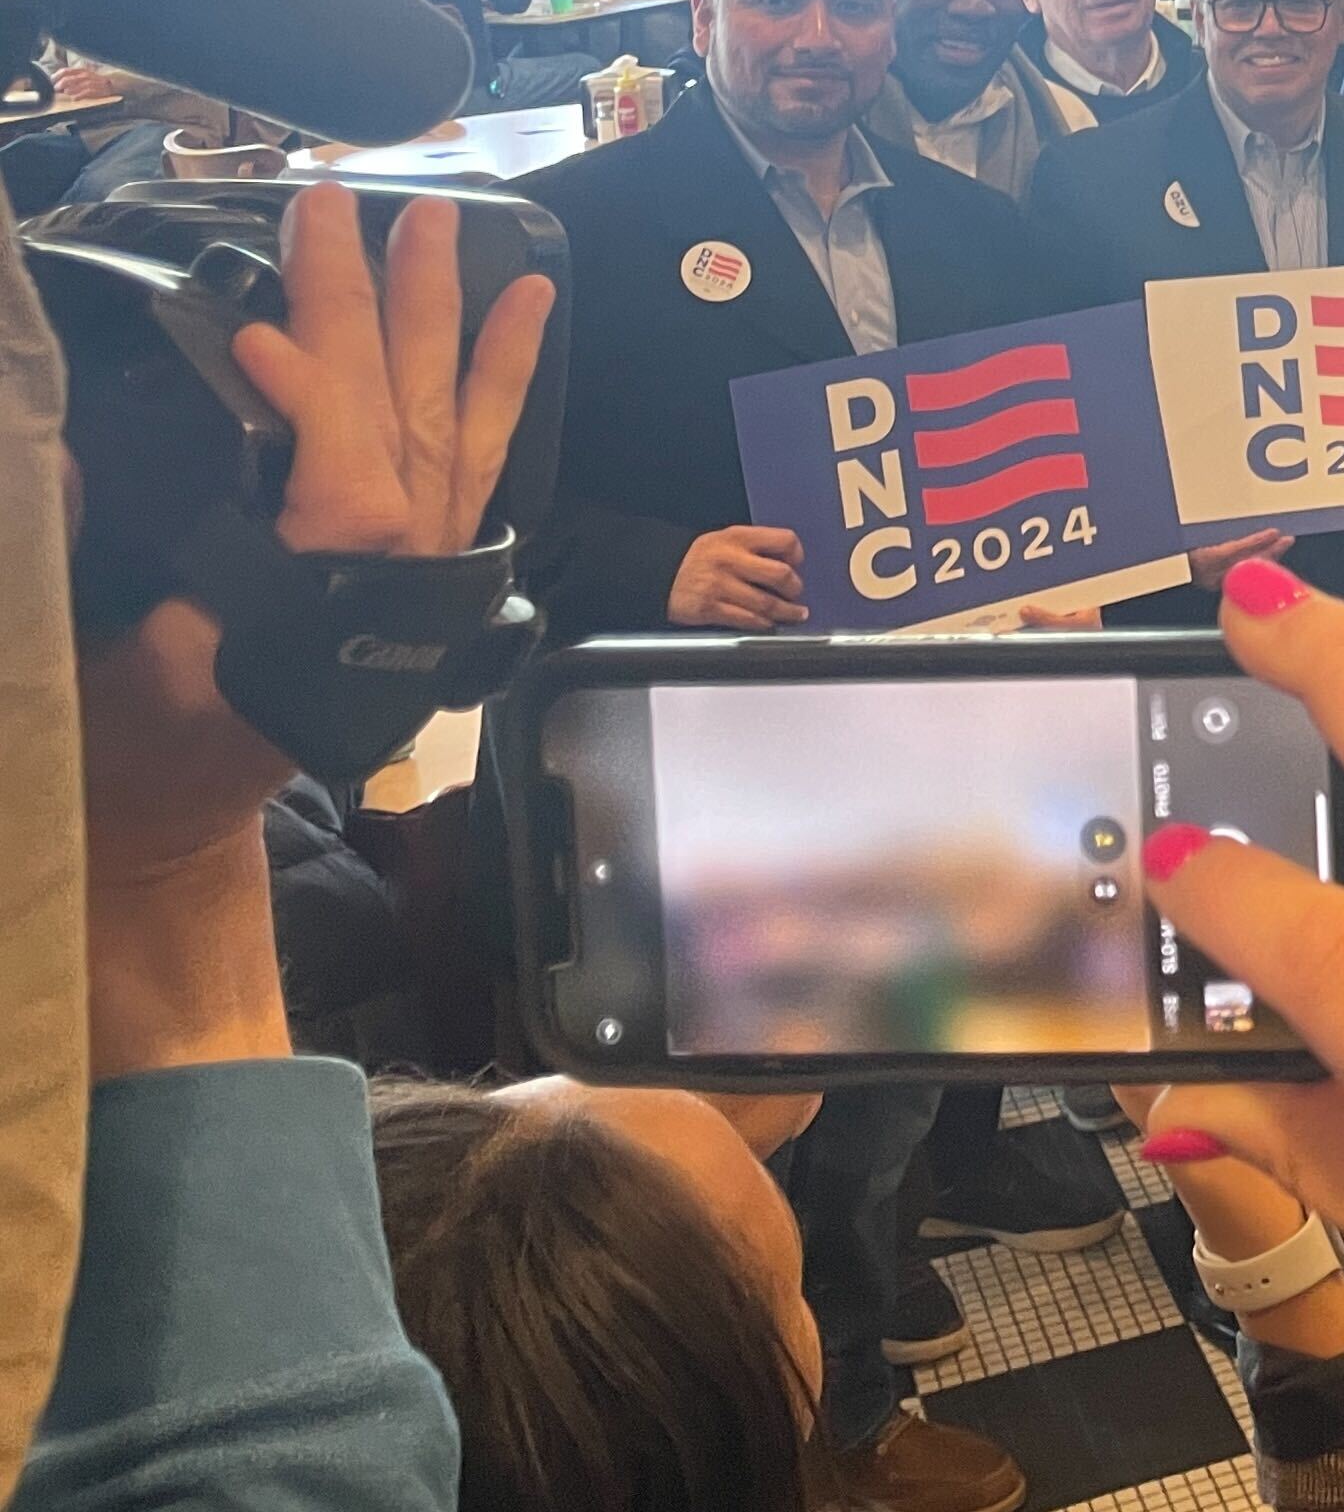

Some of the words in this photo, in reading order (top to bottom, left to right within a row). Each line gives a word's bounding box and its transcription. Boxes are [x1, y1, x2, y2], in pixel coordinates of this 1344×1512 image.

[693, 247, 712, 278] DNC
[1235, 294, 1309, 482] DNC
[825, 377, 918, 601] DNC
[930, 505, 1097, 584] 2024
[1160, 918, 1178, 975] SLO-M
